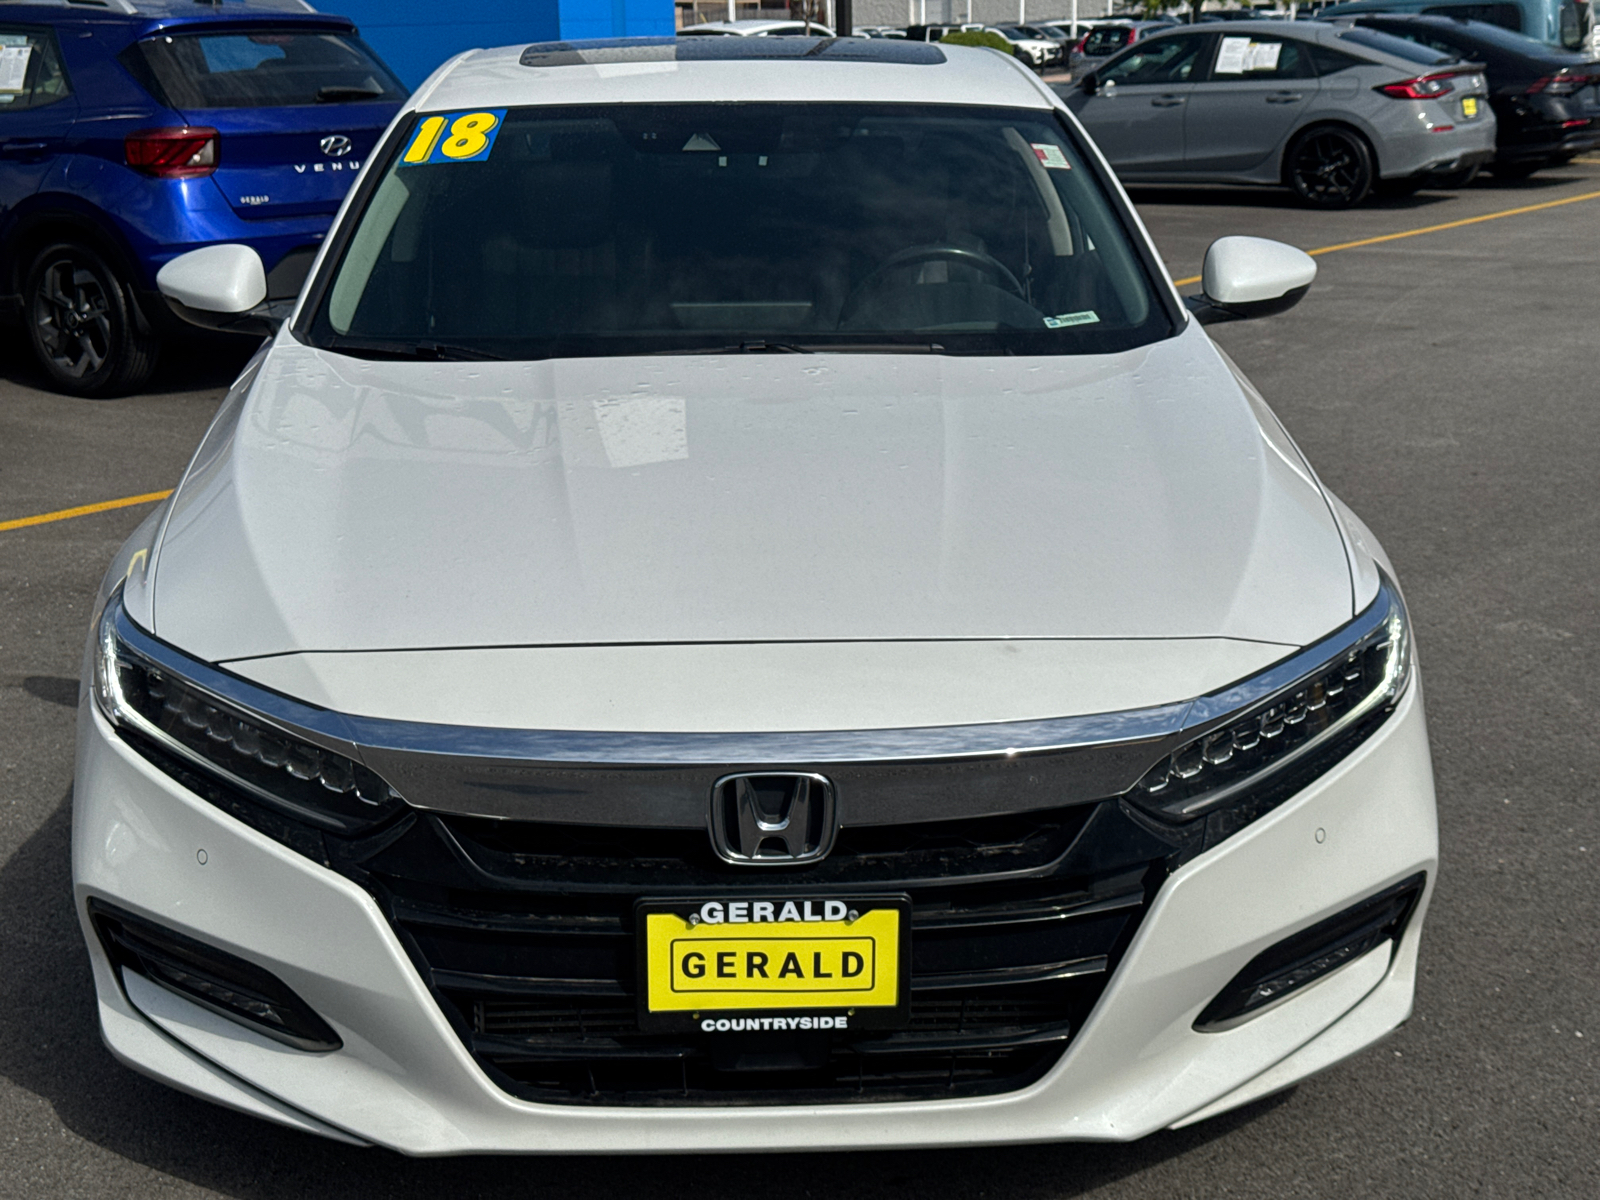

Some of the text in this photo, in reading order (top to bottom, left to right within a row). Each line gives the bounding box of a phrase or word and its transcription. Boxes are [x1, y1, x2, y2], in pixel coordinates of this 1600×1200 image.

[403, 112, 498, 163] 18
[294, 161, 360, 174] VENU
[700, 900, 848, 924] GERALD
[681, 951, 865, 979] GERALD
[700, 1016, 848, 1032] COUNTRYSIDE
